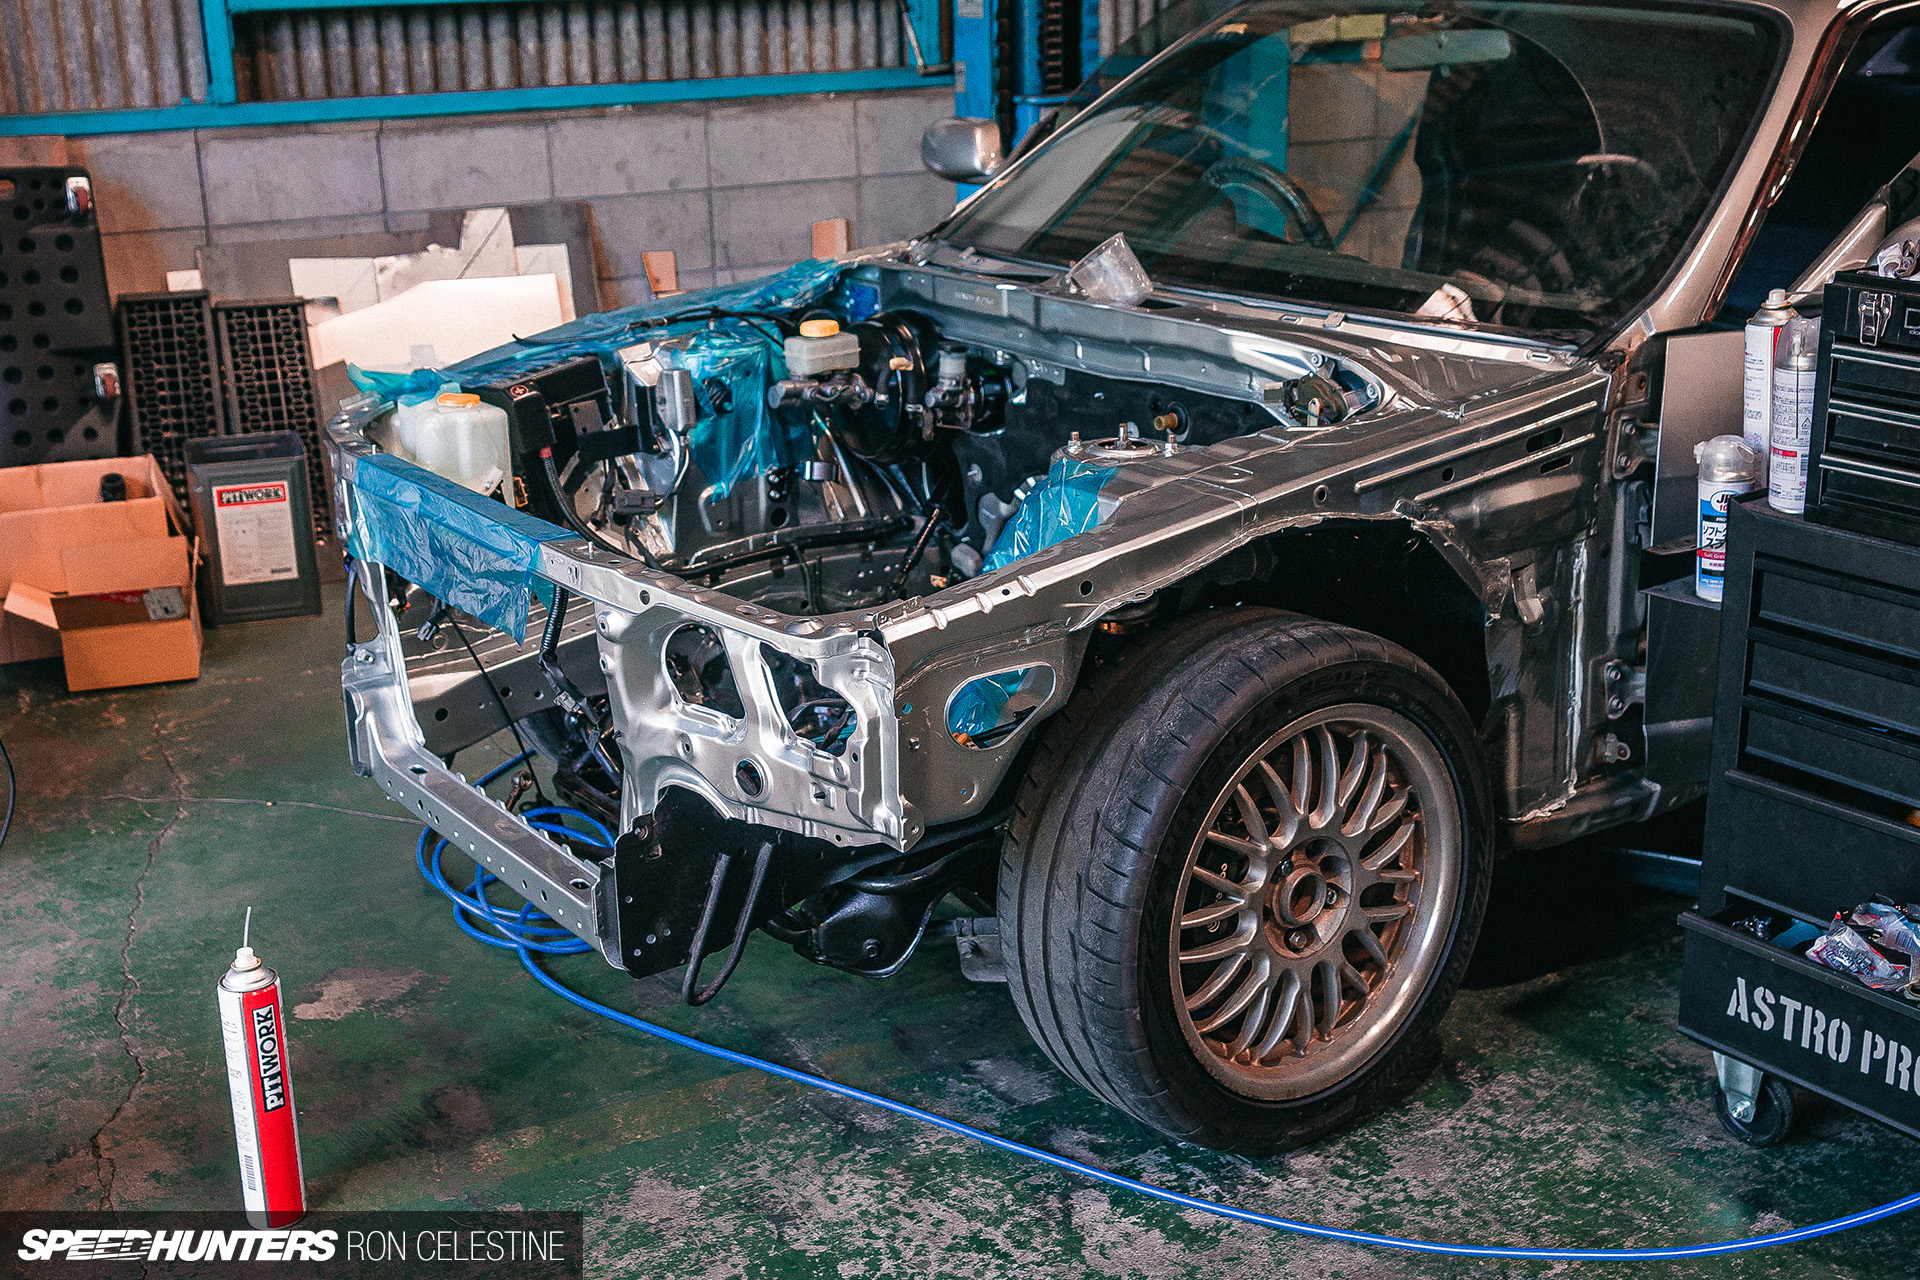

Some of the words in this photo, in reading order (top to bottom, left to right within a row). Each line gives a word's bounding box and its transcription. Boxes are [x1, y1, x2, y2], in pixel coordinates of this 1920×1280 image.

[221, 487, 283, 504] PITWORK
[255, 1007, 284, 1110] PITWORK
[1727, 976, 1851, 1063] ASTRO
